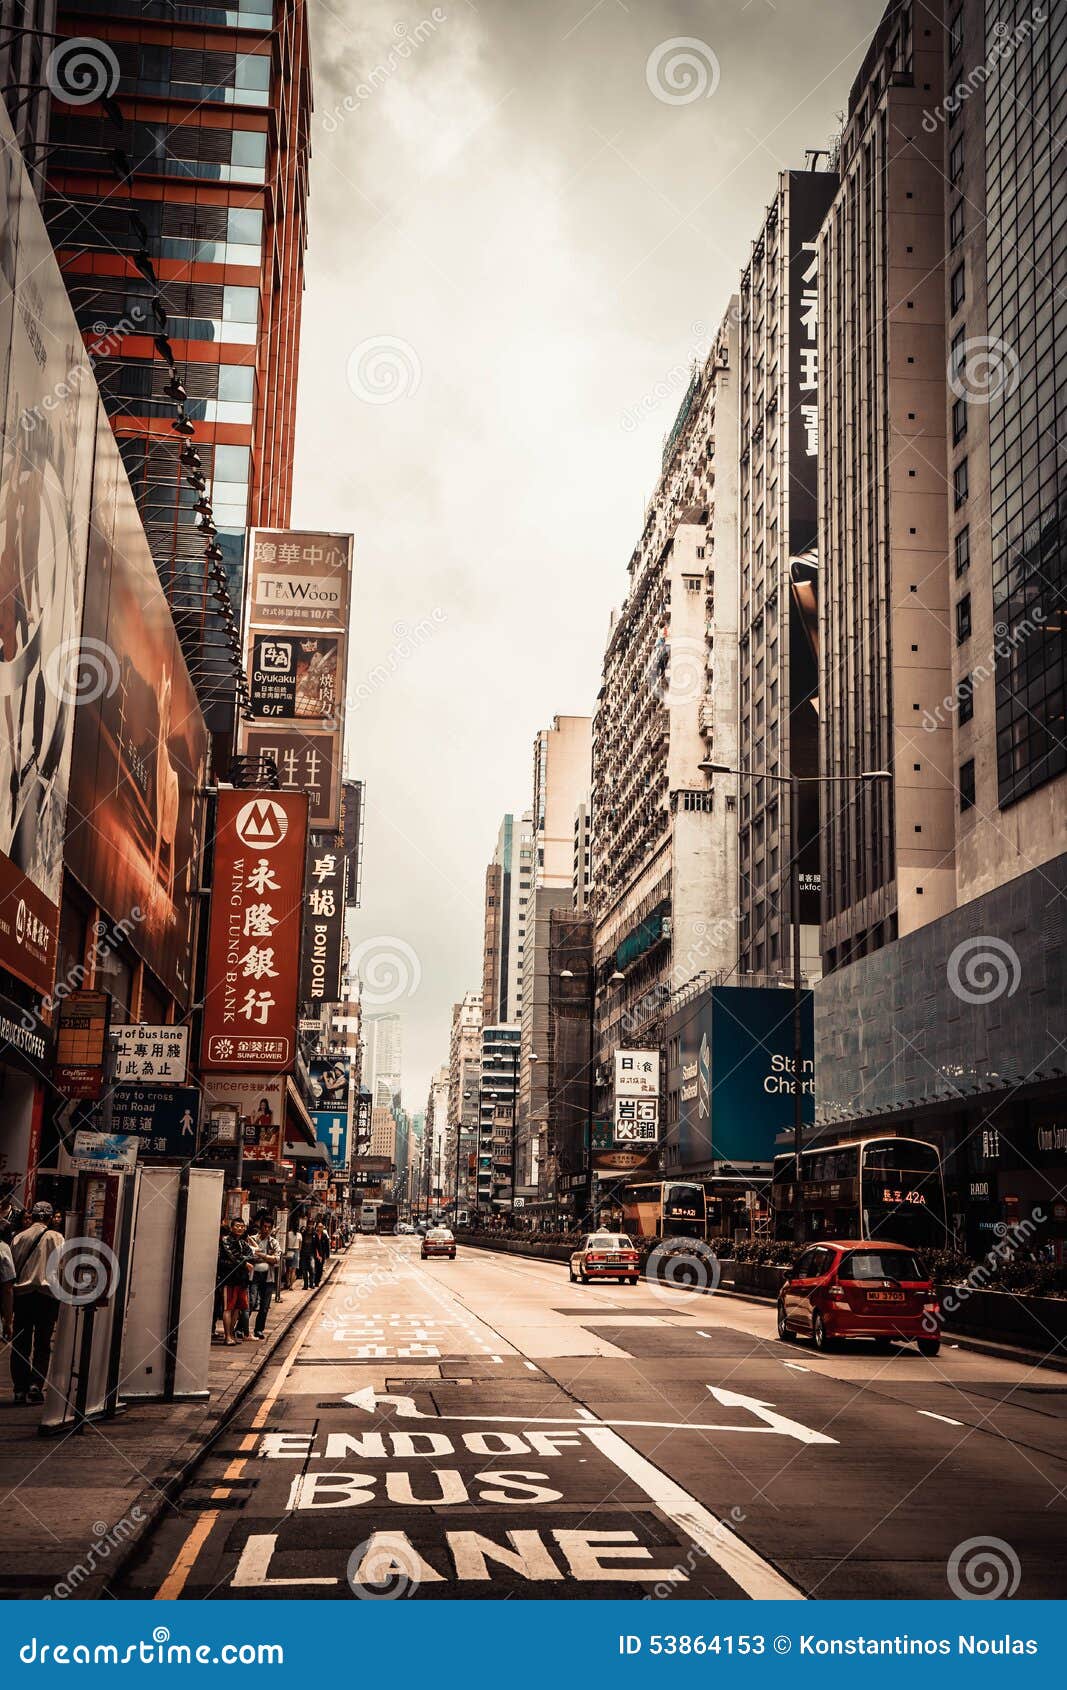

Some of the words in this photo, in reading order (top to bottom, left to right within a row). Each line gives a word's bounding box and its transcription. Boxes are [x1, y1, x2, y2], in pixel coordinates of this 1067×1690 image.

[255, 542, 348, 567] 瓊華中心
[310, 609, 334, 619] 10/F
[254, 671, 296, 684] Gyukaku
[262, 704, 284, 715] 6/F
[230, 858, 245, 906] WING
[225, 914, 241, 965] LUNG
[237, 858, 281, 1025] 永隆銀行
[311, 925, 328, 999] BONJOUR
[223, 975, 238, 1024] BANK
[0, 1015, 26, 1049] RBUCKS
[125, 1030, 136, 1039] of
[138, 1030, 158, 1039] bus
[160, 1030, 183, 1040] lane
[237, 1052, 282, 1060] SUNFLOWER
[207, 1080, 249, 1092] sincere
[134, 1092, 144, 1100] to
[148, 1093, 174, 1101] cross
[131, 1102, 155, 1112] Road
[905, 1191, 926, 1204] 42A
[970, 1182, 989, 1195] RADO
[257, 1431, 453, 1460] END
[461, 1429, 587, 1457] OF
[287, 1469, 564, 1510] BUS
[230, 1529, 690, 1588] LANE
